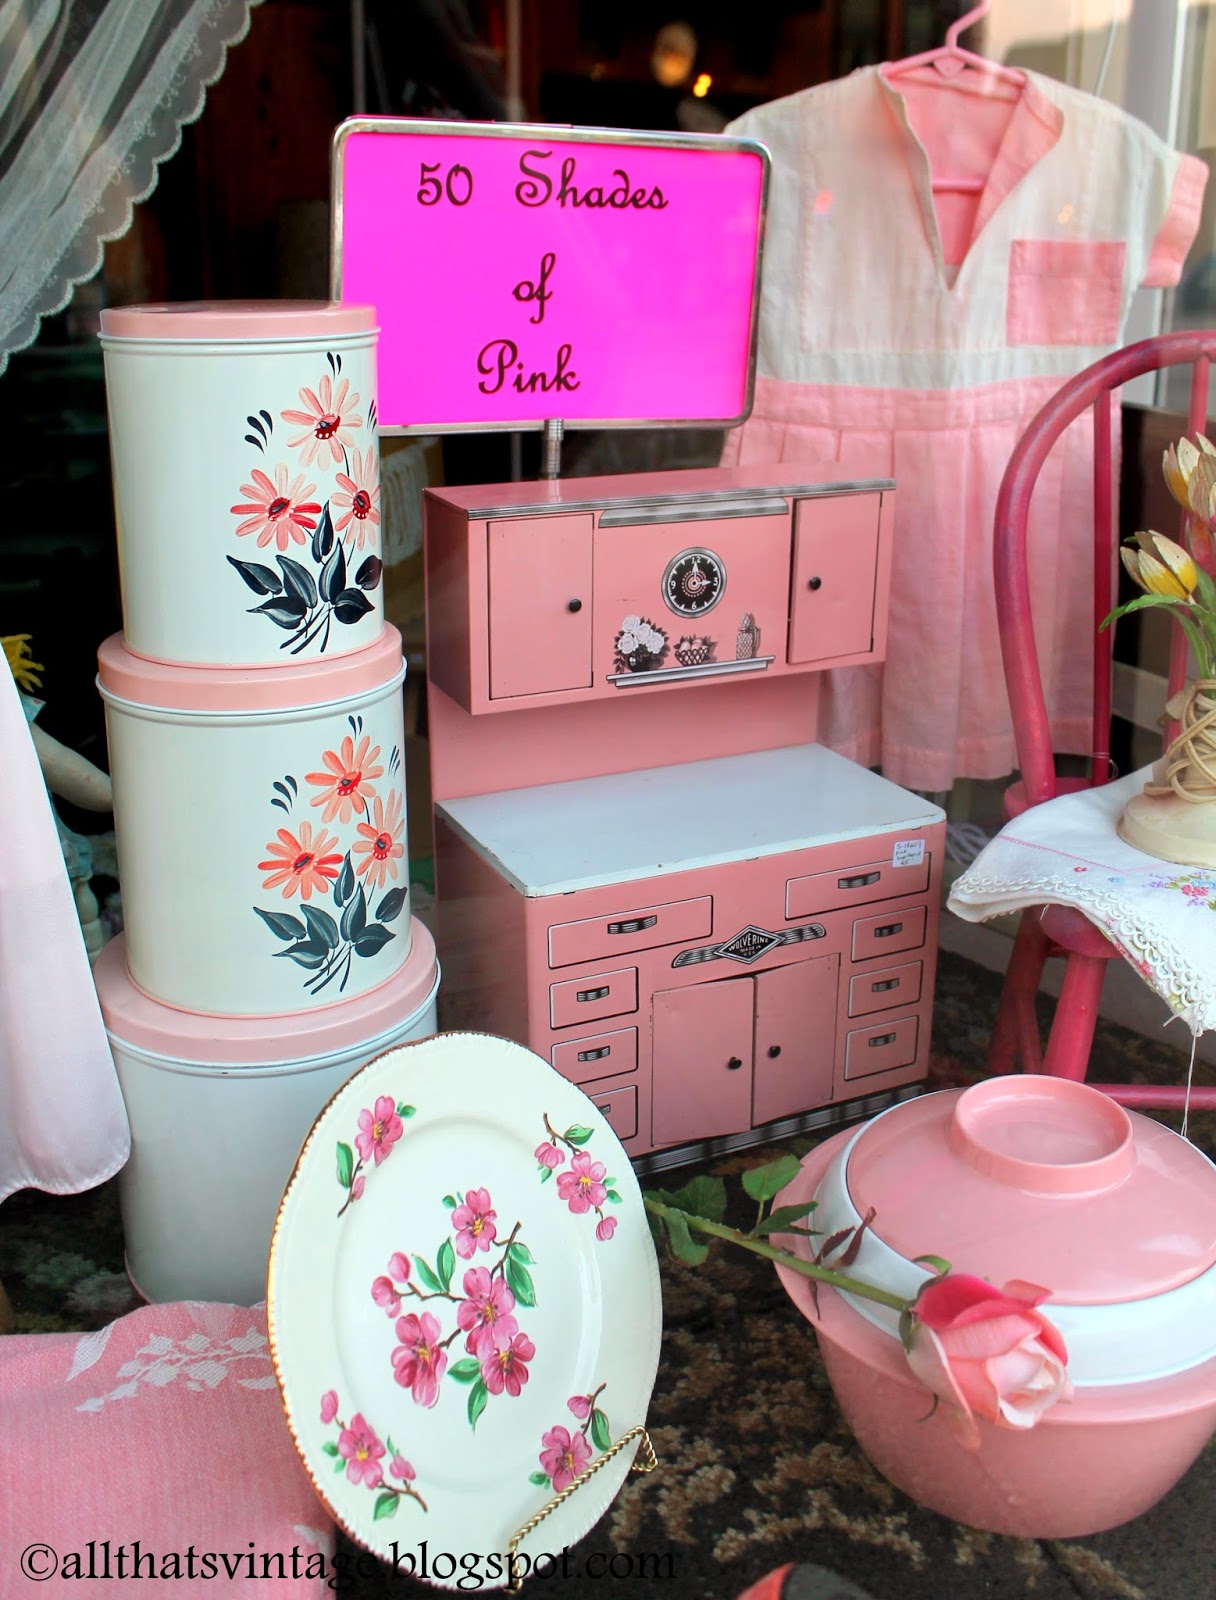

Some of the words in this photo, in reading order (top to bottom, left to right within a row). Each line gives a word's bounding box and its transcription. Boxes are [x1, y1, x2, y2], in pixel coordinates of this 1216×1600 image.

[416, 162, 474, 206] 50
[514, 149, 669, 210] Shades
[511, 252, 557, 324] of
[476, 338, 580, 395] Pink
[692, 556, 701, 564] 12
[671, 580, 676, 589] 9
[713, 577, 718, 586] 3
[691, 602, 697, 610] 6
[728, 932, 769, 951] WOLVERINE
